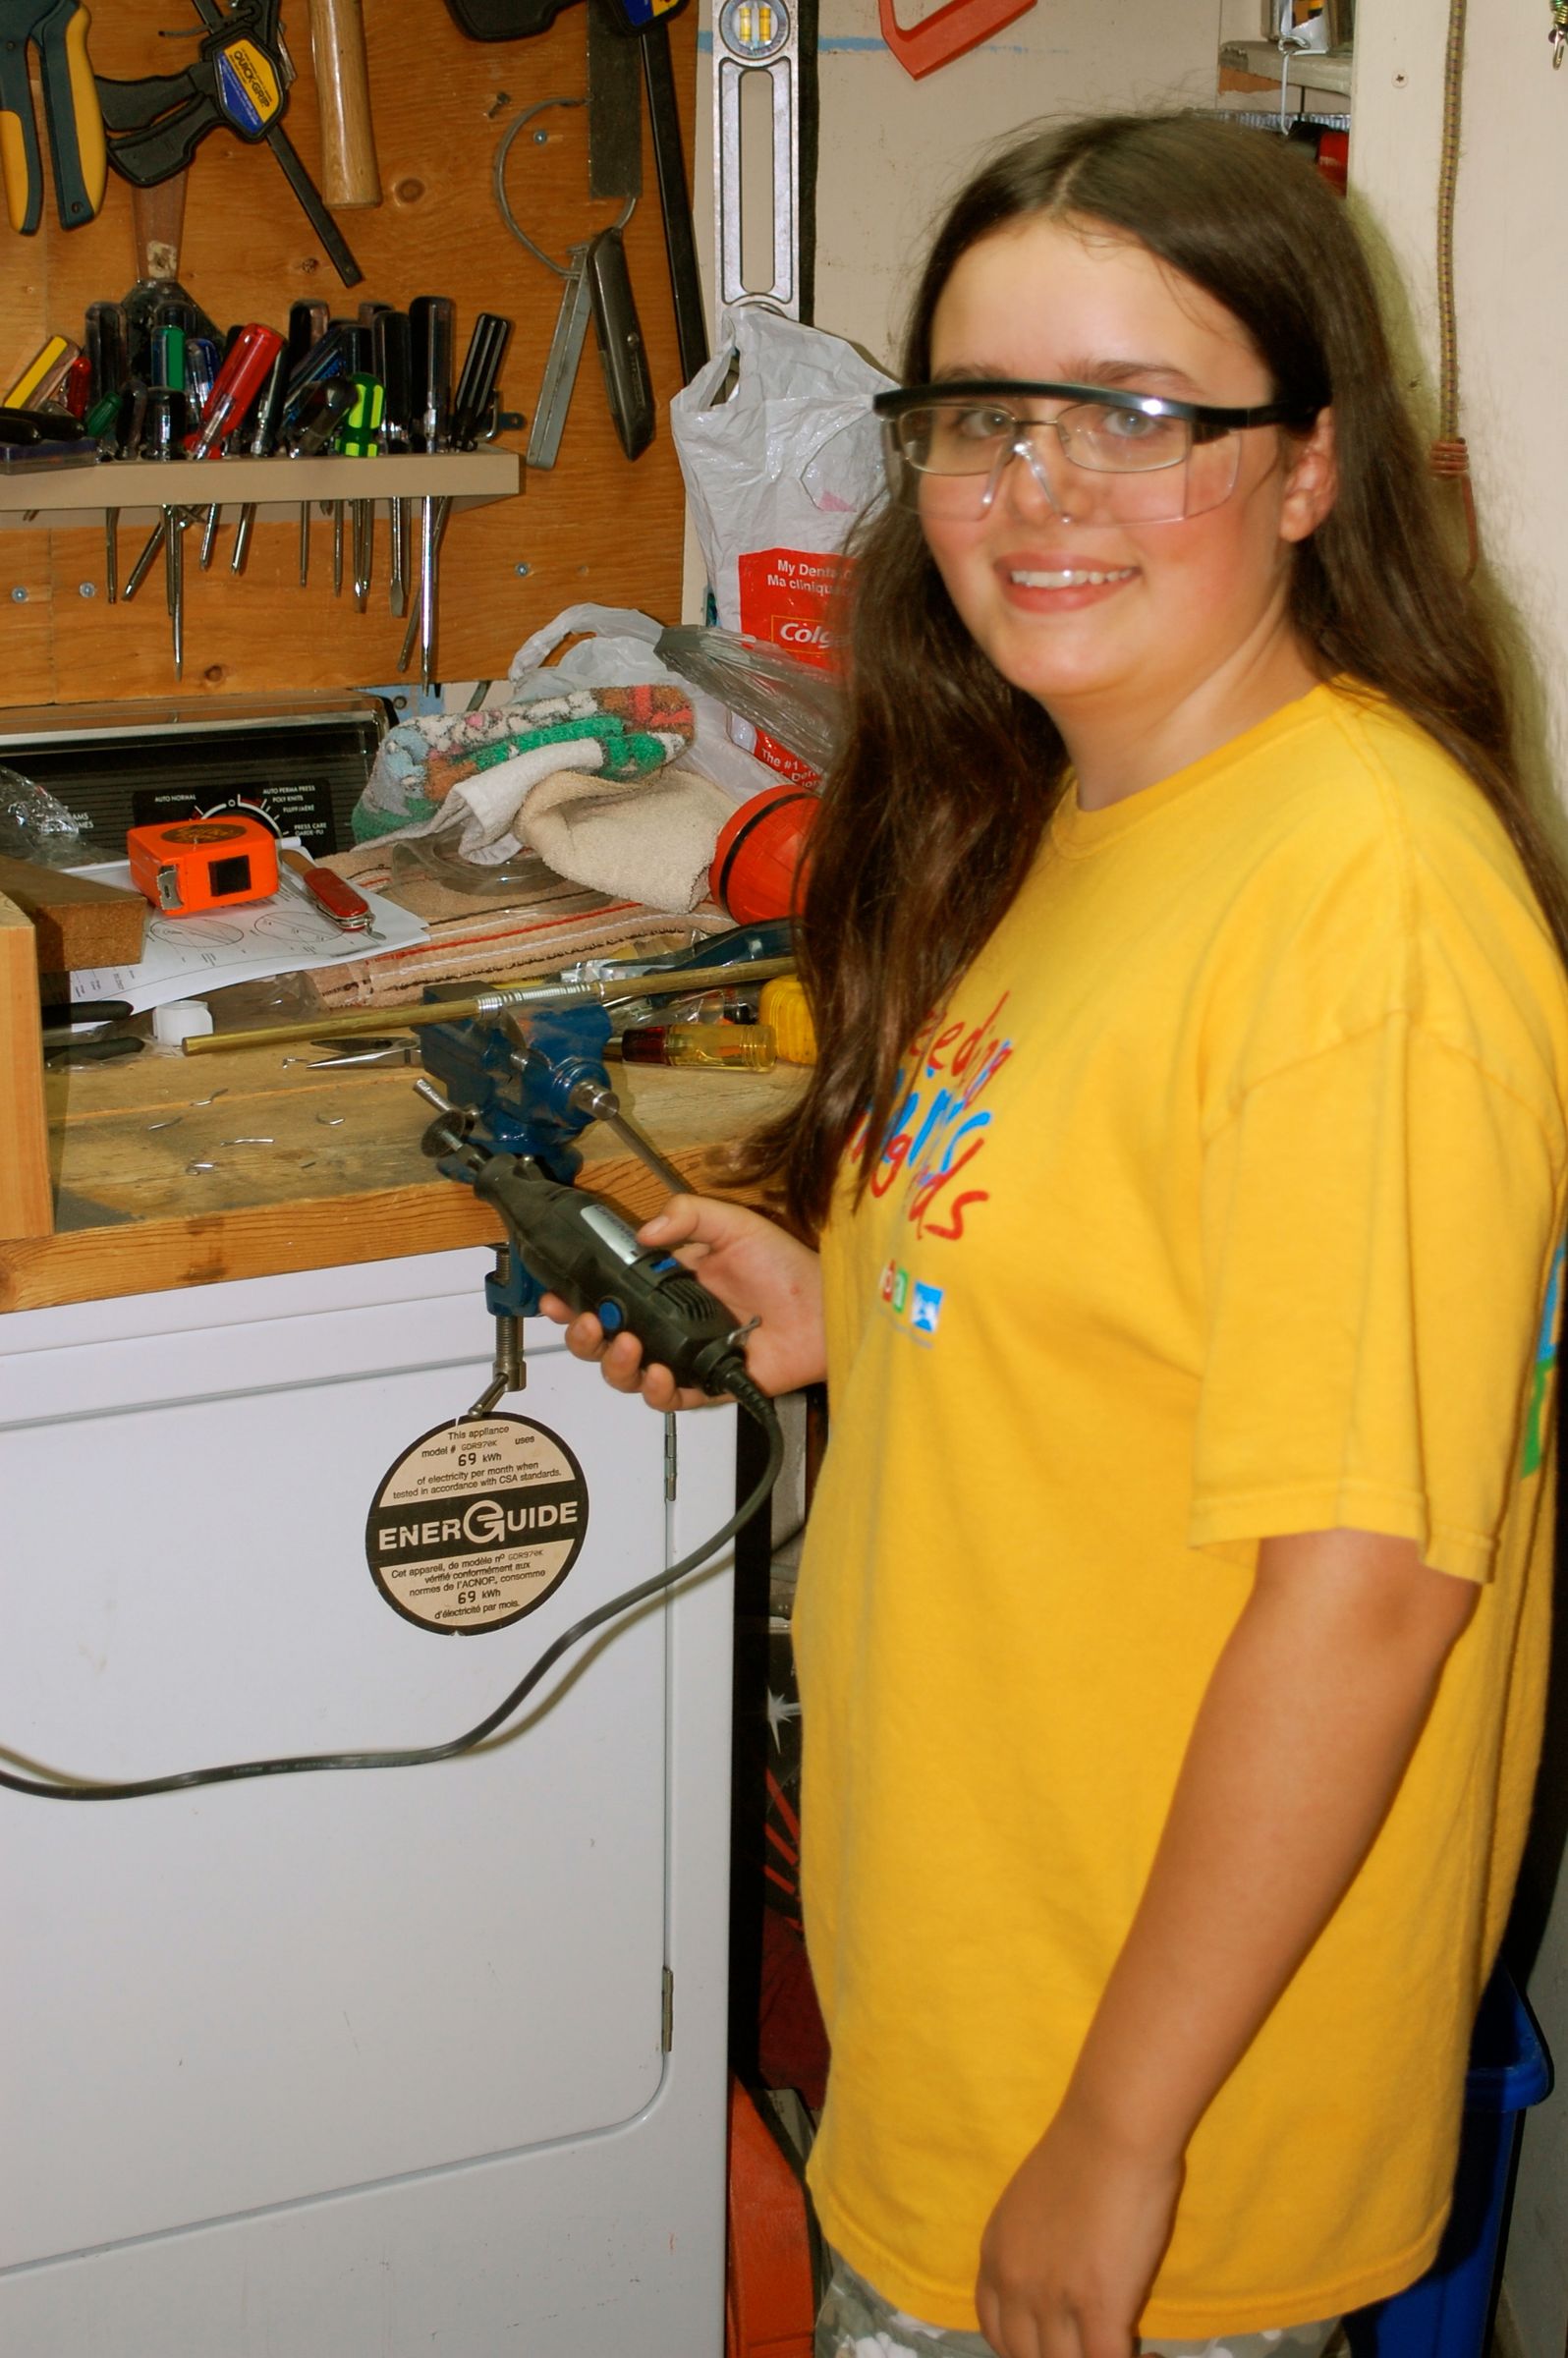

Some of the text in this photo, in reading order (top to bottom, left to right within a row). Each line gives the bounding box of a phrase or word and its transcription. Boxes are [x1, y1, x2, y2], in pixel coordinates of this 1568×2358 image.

[234, 50, 270, 108] QUICK-GRIP
[777, 559, 796, 577] My
[767, 574, 835, 597] Ma cliniqu
[780, 622, 837, 649] Colg
[762, 748, 799, 771] The #1
[448, 1426, 510, 1441] This appliance
[421, 1445, 448, 1458] model
[450, 1444, 457, 1454] #
[515, 1435, 535, 1445] uses
[458, 1452, 502, 1467] 69 kWh
[393, 1468, 562, 1499] tested in accordance with CSA standards.
[417, 1461, 539, 1486] of electricity per month when
[378, 1499, 579, 1550] ENERGUIDE
[391, 1568, 407, 1579] Cet
[409, 1564, 446, 1577] appareil,
[448, 1560, 460, 1571] de
[461, 1556, 492, 1568] modèle
[424, 1561, 532, 1585] vérifié conformément aux
[409, 1586, 441, 1598] normes
[443, 1581, 454, 1591] de
[500, 1569, 546, 1584] consomme
[458, 1589, 501, 1604] 69 kWh
[434, 1600, 520, 1620] d'électricité par mois.
